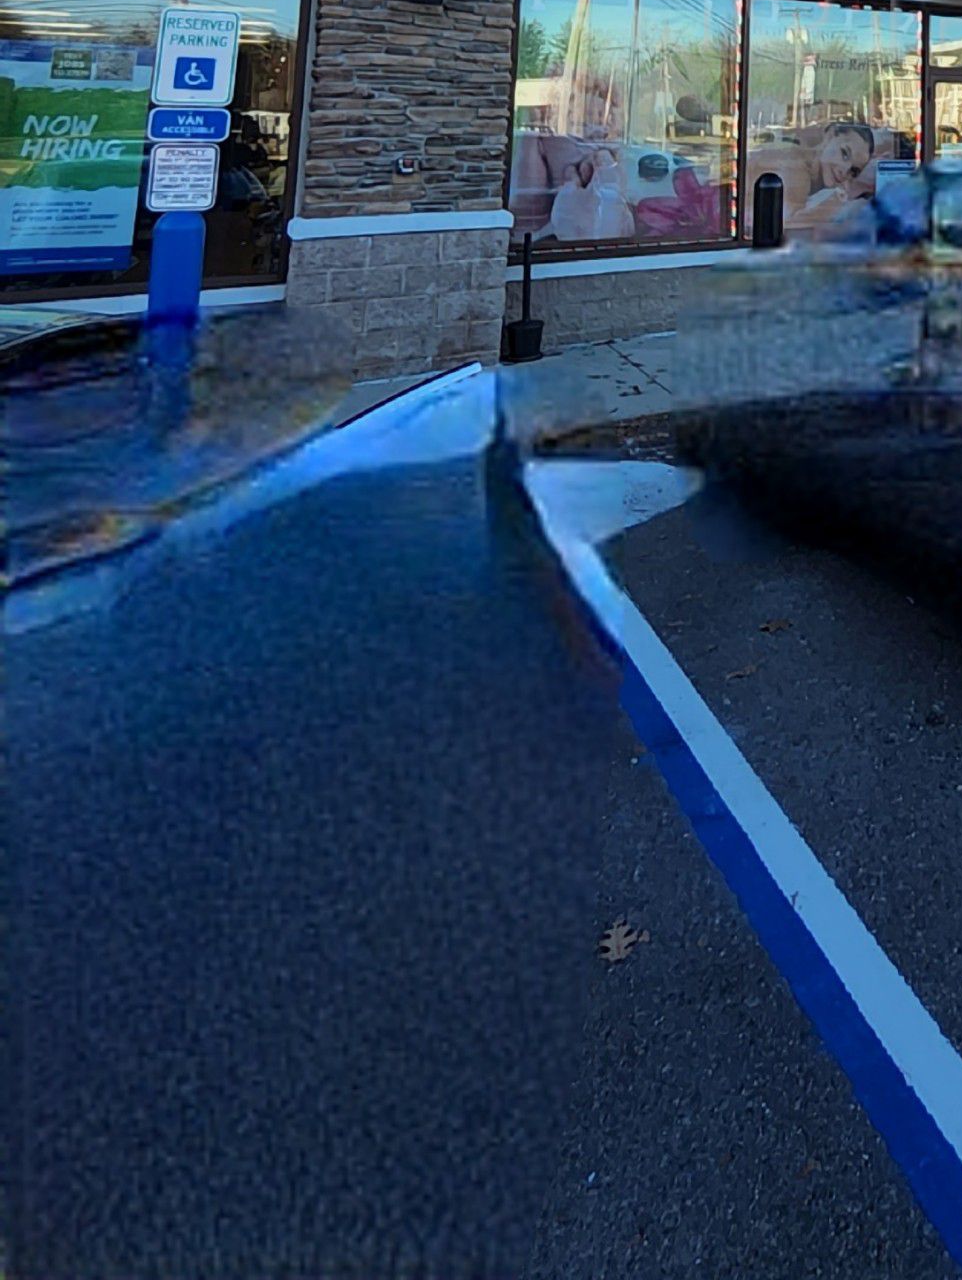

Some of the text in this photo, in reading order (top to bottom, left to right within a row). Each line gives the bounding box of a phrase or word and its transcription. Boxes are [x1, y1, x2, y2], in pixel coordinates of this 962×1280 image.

[166, 17, 235, 32] RESERVED
[169, 33, 229, 48] PARKING
[23, 114, 98, 137] NOW
[177, 115, 204, 125] VAN
[20, 138, 126, 161] HIRING
